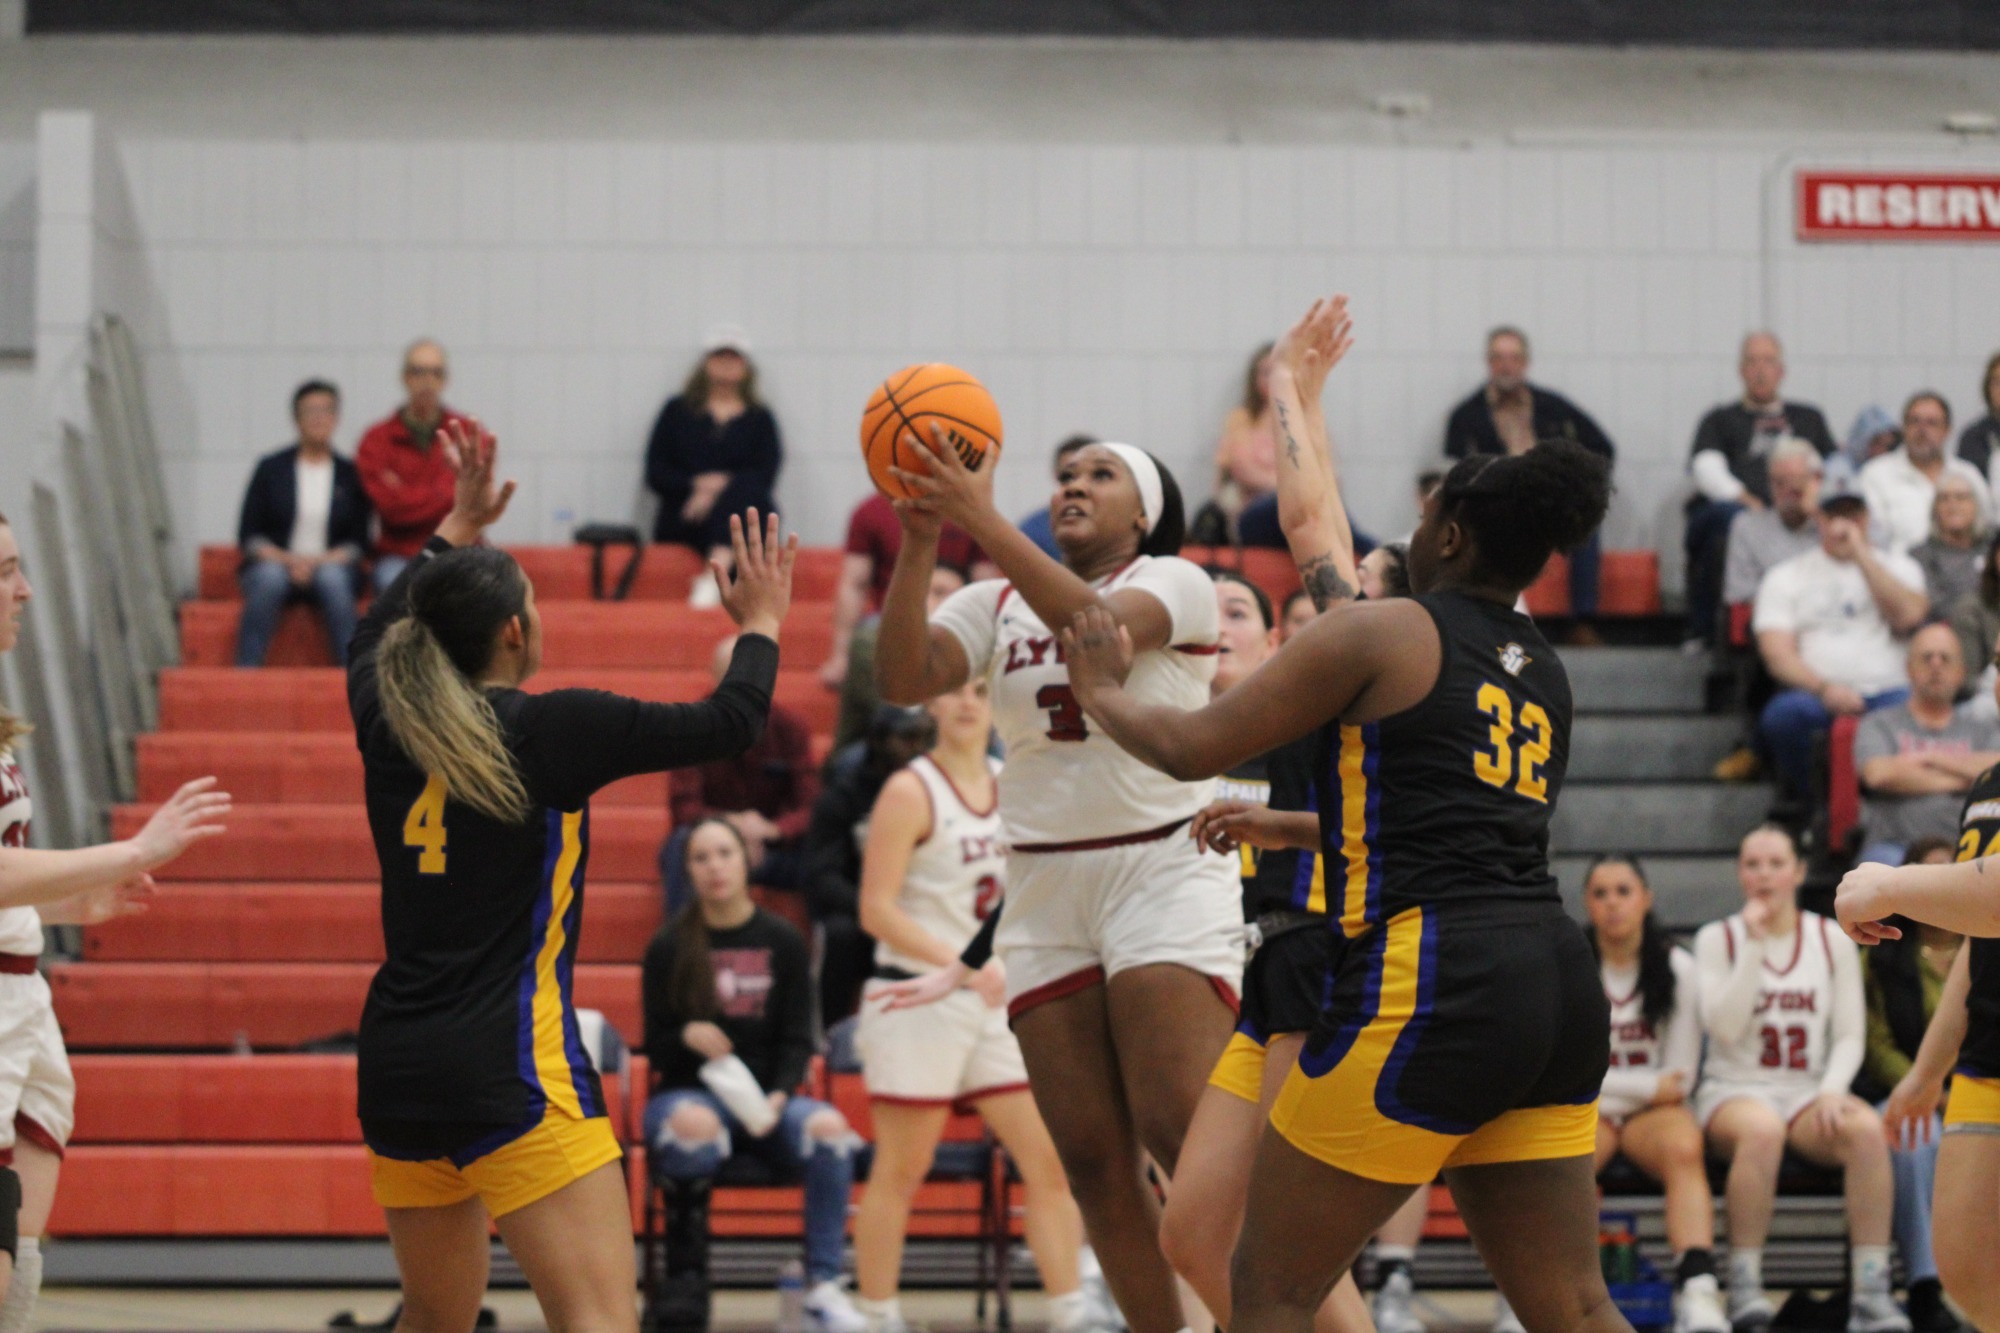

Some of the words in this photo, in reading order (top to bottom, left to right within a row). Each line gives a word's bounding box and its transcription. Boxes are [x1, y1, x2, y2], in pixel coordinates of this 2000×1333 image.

[1036, 685, 1089, 741] 3
[1473, 681, 1553, 804] 32
[403, 771, 447, 874] 4
[1760, 1025, 1808, 1069] 32
